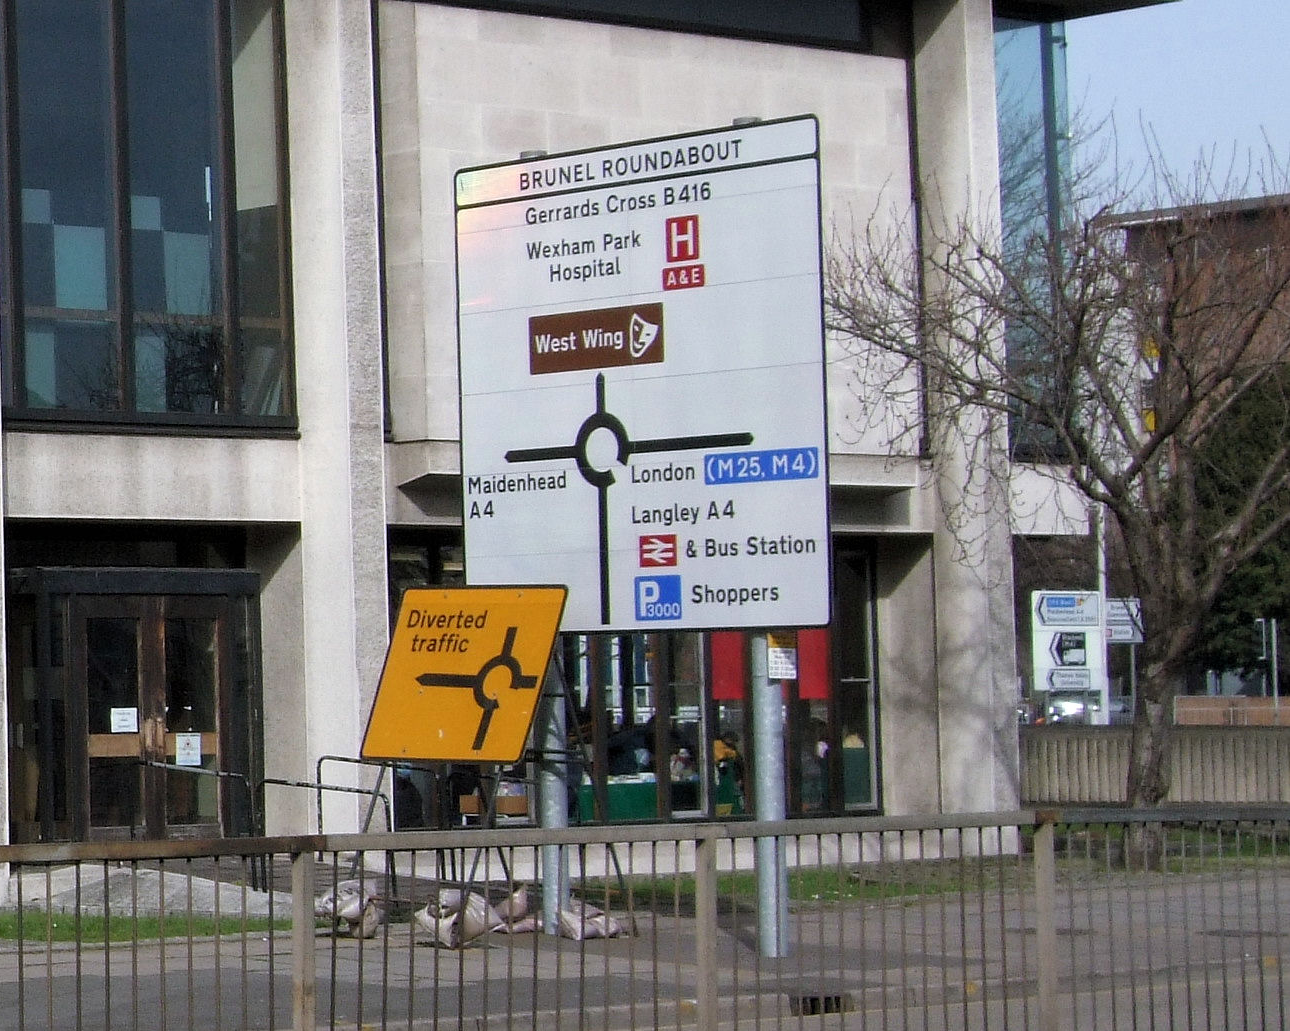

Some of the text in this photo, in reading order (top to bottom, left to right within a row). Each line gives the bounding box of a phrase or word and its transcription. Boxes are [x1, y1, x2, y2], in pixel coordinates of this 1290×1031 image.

[519, 139, 743, 191] BRUNEL ROUNDABOUT
[525, 182, 712, 225] Gerrards Cross B416
[526, 230, 642, 260] Wexham Park
[671, 220, 694, 258] H
[550, 257, 622, 284] Hospital
[535, 326, 624, 354] West Wing
[468, 471, 567, 495] Maidenhead
[631, 463, 696, 484] London
[469, 500, 495, 519] A4
[631, 500, 735, 527] Langley A4
[705, 539, 739, 557] Bus
[746, 535, 816, 556] Station
[639, 580, 658, 617] P
[691, 584, 779, 605] Shoppers
[407, 609, 489, 629] Diverted
[646, 602, 680, 618] 3000
[410, 634, 470, 653] traffic
